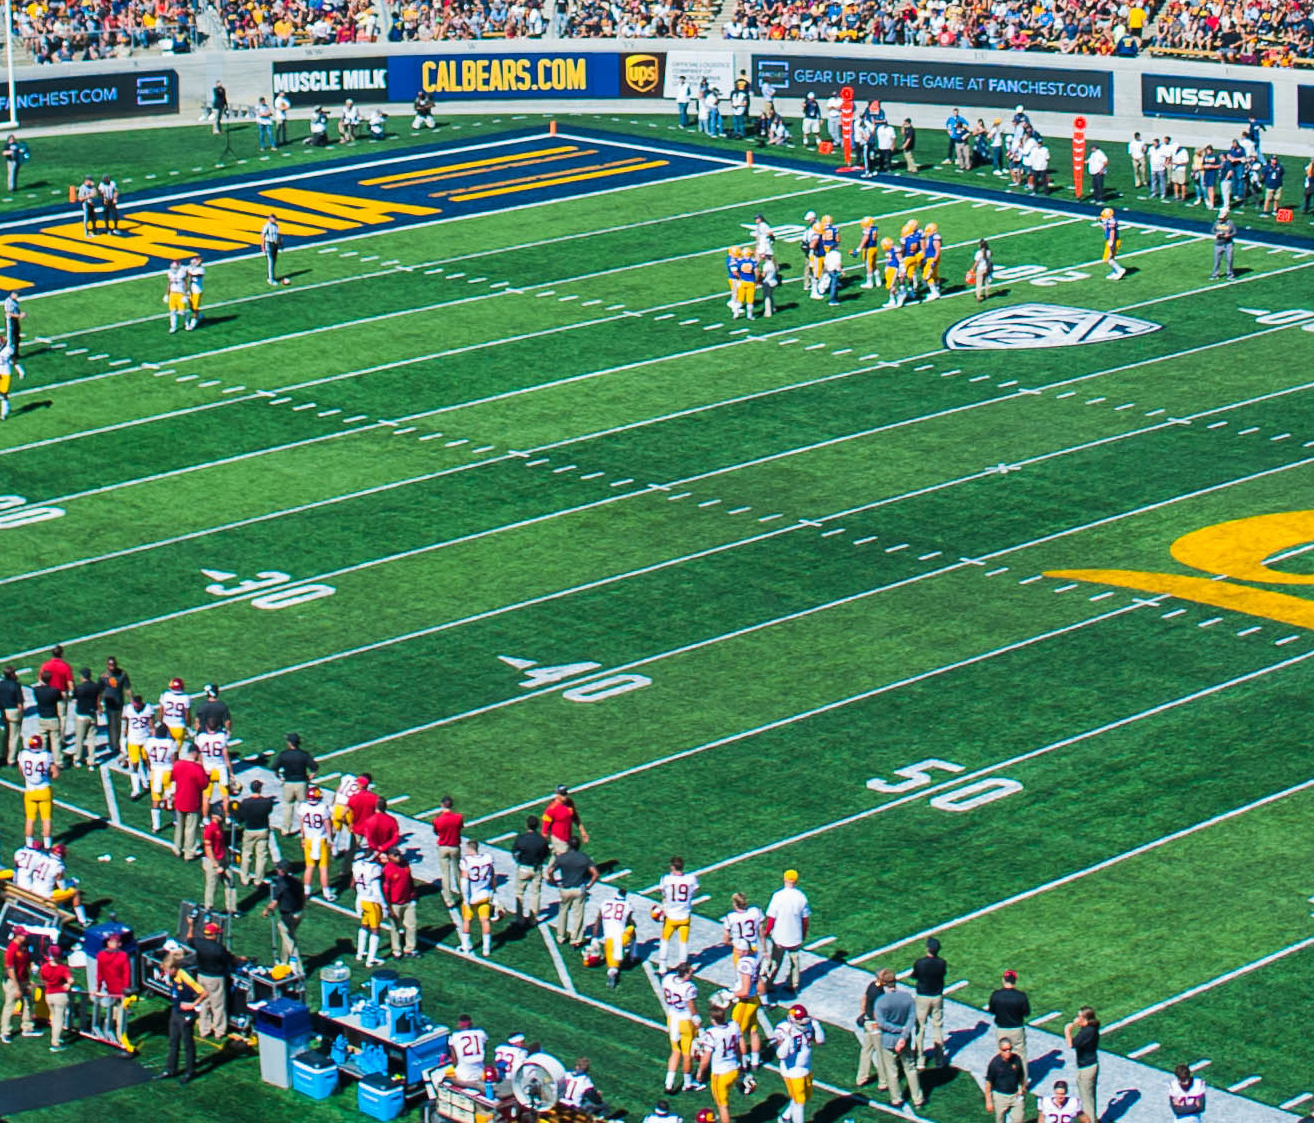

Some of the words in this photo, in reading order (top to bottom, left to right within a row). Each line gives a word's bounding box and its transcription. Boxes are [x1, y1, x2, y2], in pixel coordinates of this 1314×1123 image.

[274, 71, 341, 93] MUSCLE
[342, 69, 387, 90] MILK
[422, 58, 587, 93] CALBEARS.COM
[628, 66, 656, 86] ups
[794, 69, 832, 84] GEAR
[837, 71, 856, 85] UP
[859, 72, 888, 86] FOR
[891, 73, 920, 88] THE
[923, 76, 964, 91] GAME
[967, 78, 987, 91] AT
[988, 79, 1102, 98] FANCHEST.COM
[1156, 87, 1252, 110] NISSAN
[206, 571, 336, 609] 30
[518, 661, 652, 703] 40
[165, 702, 185, 718] 29
[149, 746, 168, 763] 47
[201, 741, 222, 758] 46
[24, 760, 46, 777] 84
[864, 757, 1024, 812] 50
[302, 812, 323, 829] 48
[355, 873, 366, 890] 4
[469, 863, 493, 882] 37
[671, 883, 689, 902] 19
[603, 902, 625, 921] 28
[737, 919, 756, 938] 13
[664, 988, 685, 1011] 82
[460, 1034, 482, 1057] 21
[723, 1033, 740, 1058] 14
